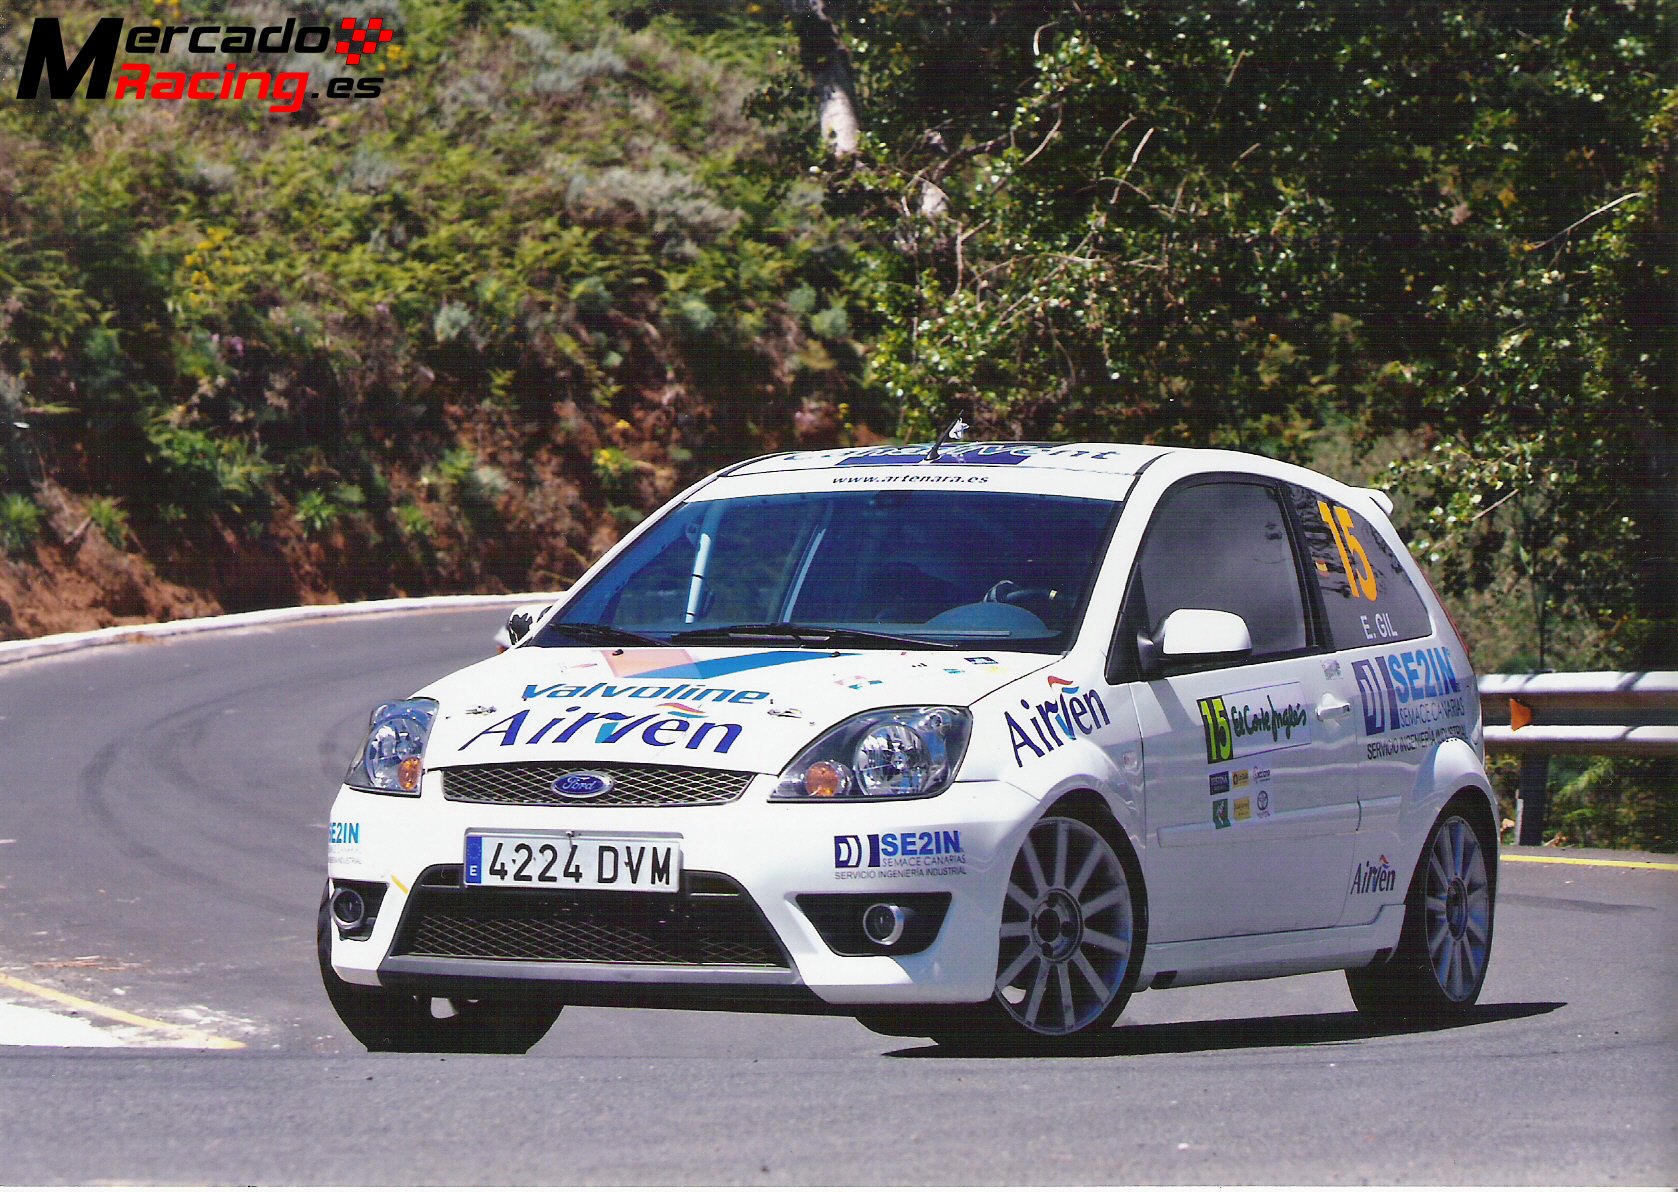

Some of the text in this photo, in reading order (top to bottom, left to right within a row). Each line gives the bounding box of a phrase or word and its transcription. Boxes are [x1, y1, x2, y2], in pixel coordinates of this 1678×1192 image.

[832, 474, 989, 484] www.artenara.es
[1317, 500, 1378, 602] 15
[1360, 613, 1398, 640] E. GIL
[1388, 646, 1460, 703] SE2IN
[1200, 698, 1231, 760] 15
[1231, 706, 1245, 737] El
[1244, 705, 1271, 735] Corte
[1367, 738, 1399, 760] SERVICIO
[562, 776, 597, 789] Ford
[329, 822, 359, 843] E2IN
[881, 831, 960, 856] SE2IN
[469, 865, 478, 876] E
[489, 842, 672, 885] 4224 DVM
[881, 854, 967, 868] SEMACE CANARIAS
[834, 871, 877, 880] SERVICIO
